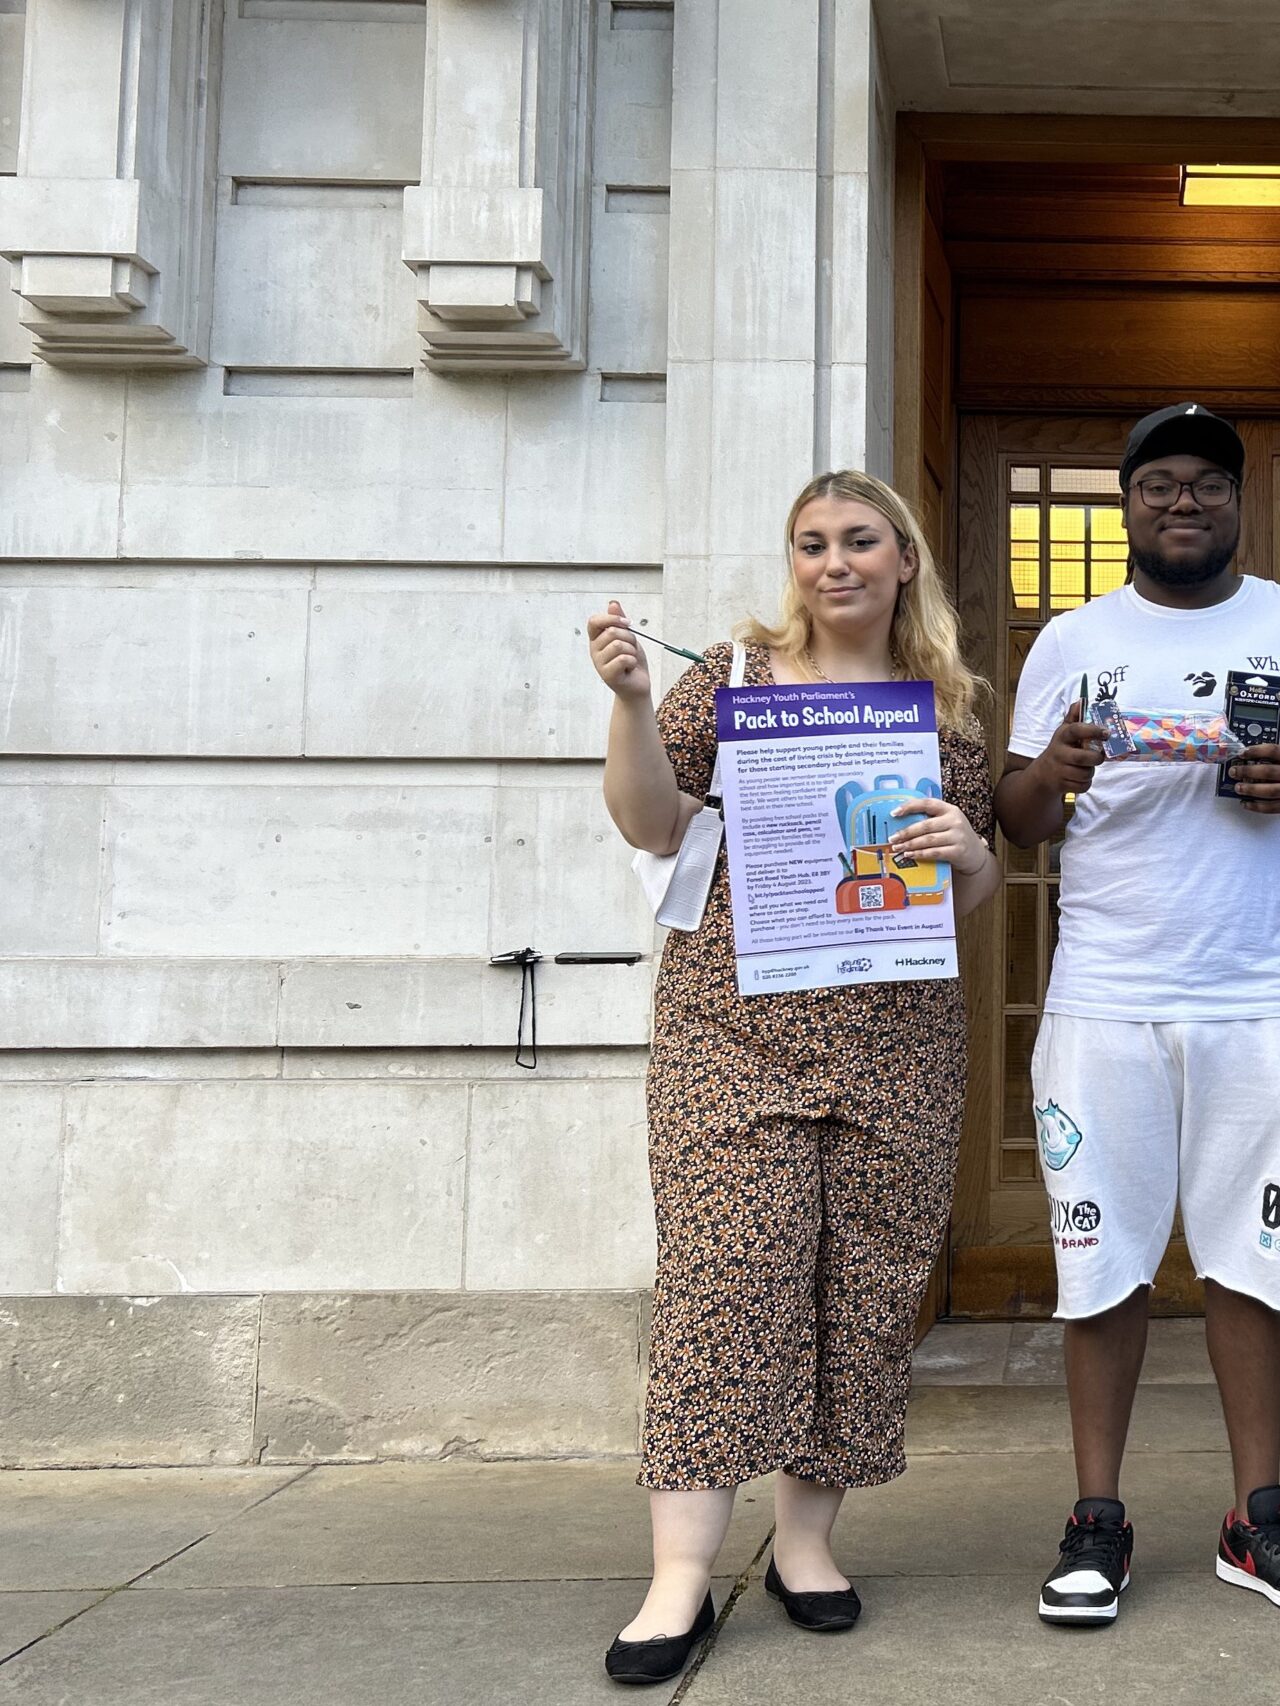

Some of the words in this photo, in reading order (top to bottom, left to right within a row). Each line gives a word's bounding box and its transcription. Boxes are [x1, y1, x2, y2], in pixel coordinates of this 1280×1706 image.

[1098, 665, 1128, 686] Off
[732, 695, 770, 703] Hackney
[772, 692, 798, 701] Youth
[800, 691, 854, 699] Parliament's
[1240, 690, 1275, 700] OXFORD
[734, 709, 776, 729] Pack
[780, 710, 798, 726] to
[802, 706, 858, 725] School
[863, 705, 918, 727] Appeal
[1076, 1203, 1097, 1216] The
[1074, 1216, 1097, 1229] CAT
[1062, 1237, 1099, 1250] BRAND
